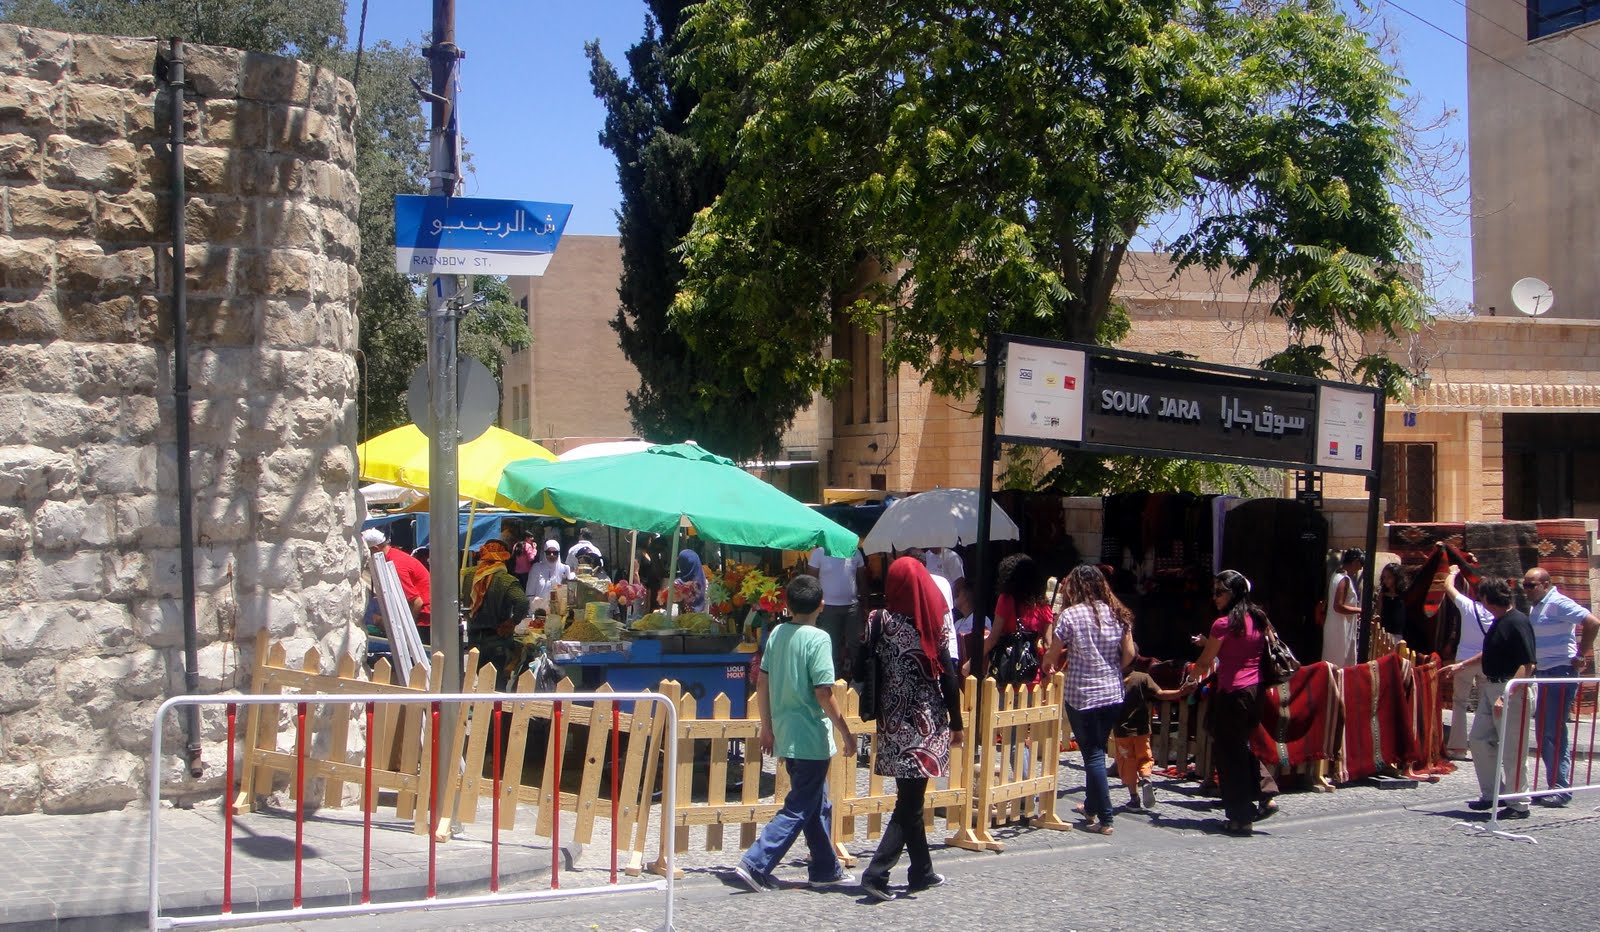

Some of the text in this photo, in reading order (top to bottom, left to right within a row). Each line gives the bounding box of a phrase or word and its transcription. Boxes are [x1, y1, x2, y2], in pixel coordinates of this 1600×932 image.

[430, 209, 525, 238] الرينبو
[412, 255, 492, 267] RAINBOW ST.
[1101, 389, 1201, 420] SOUK JARA
[1221, 395, 1305, 434] سوق جارا
